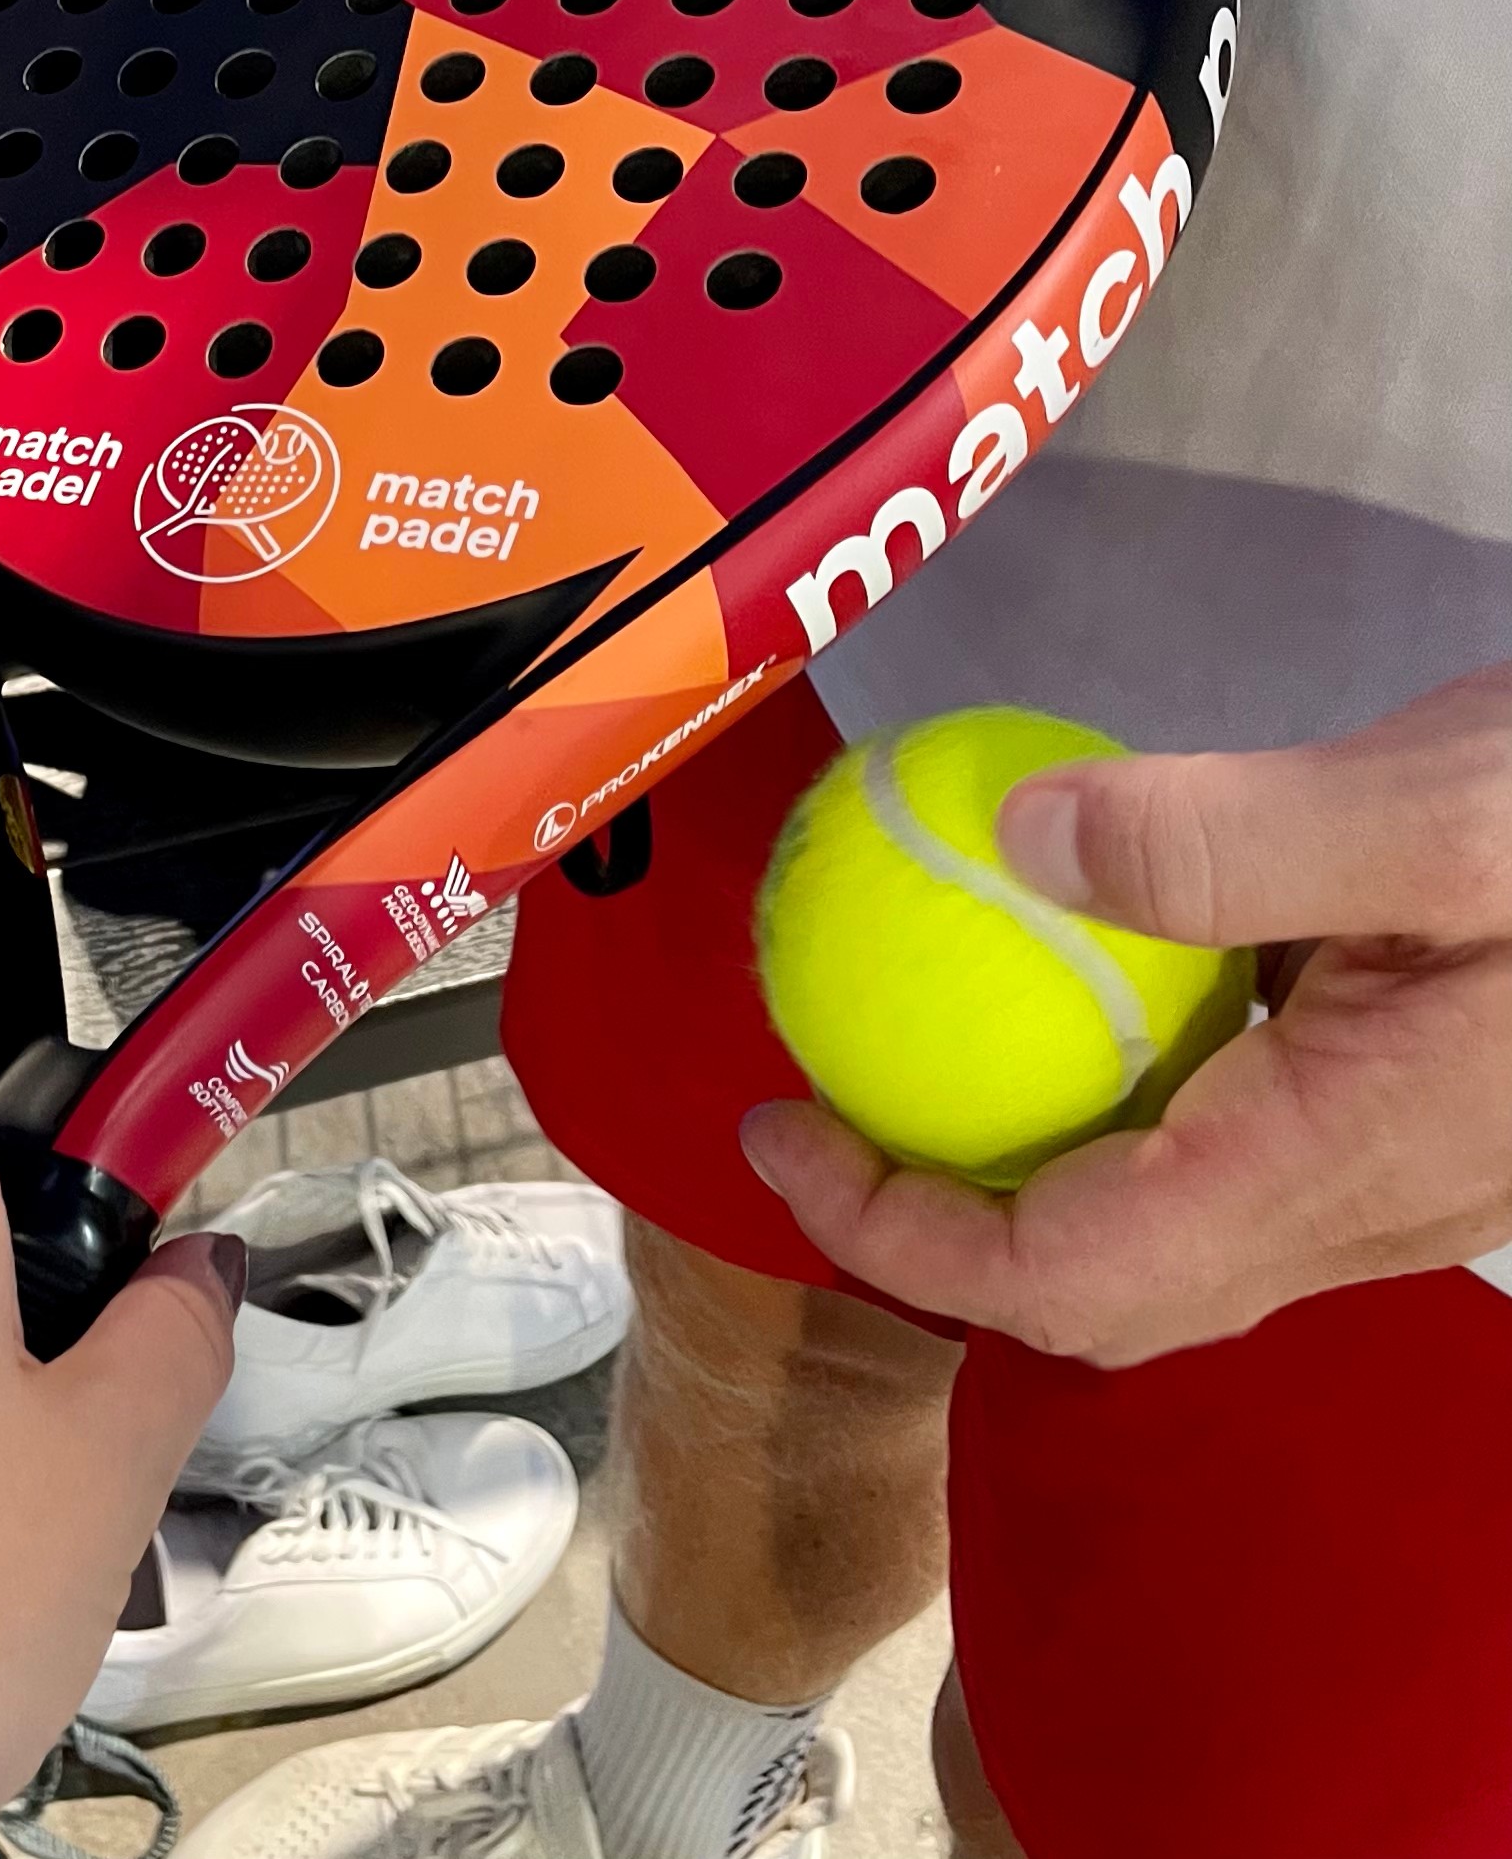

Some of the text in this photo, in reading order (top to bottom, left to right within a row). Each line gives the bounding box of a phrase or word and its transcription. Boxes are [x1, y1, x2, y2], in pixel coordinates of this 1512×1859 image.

[785, 153, 1194, 660] match
[366, 471, 541, 519] match
[360, 512, 520, 561] padel
[580, 660, 766, 818] PROKENNEX
[381, 894, 414, 934] HOLE
[297, 911, 357, 989] SPIRAL
[188, 1081, 222, 1116] SOFT
